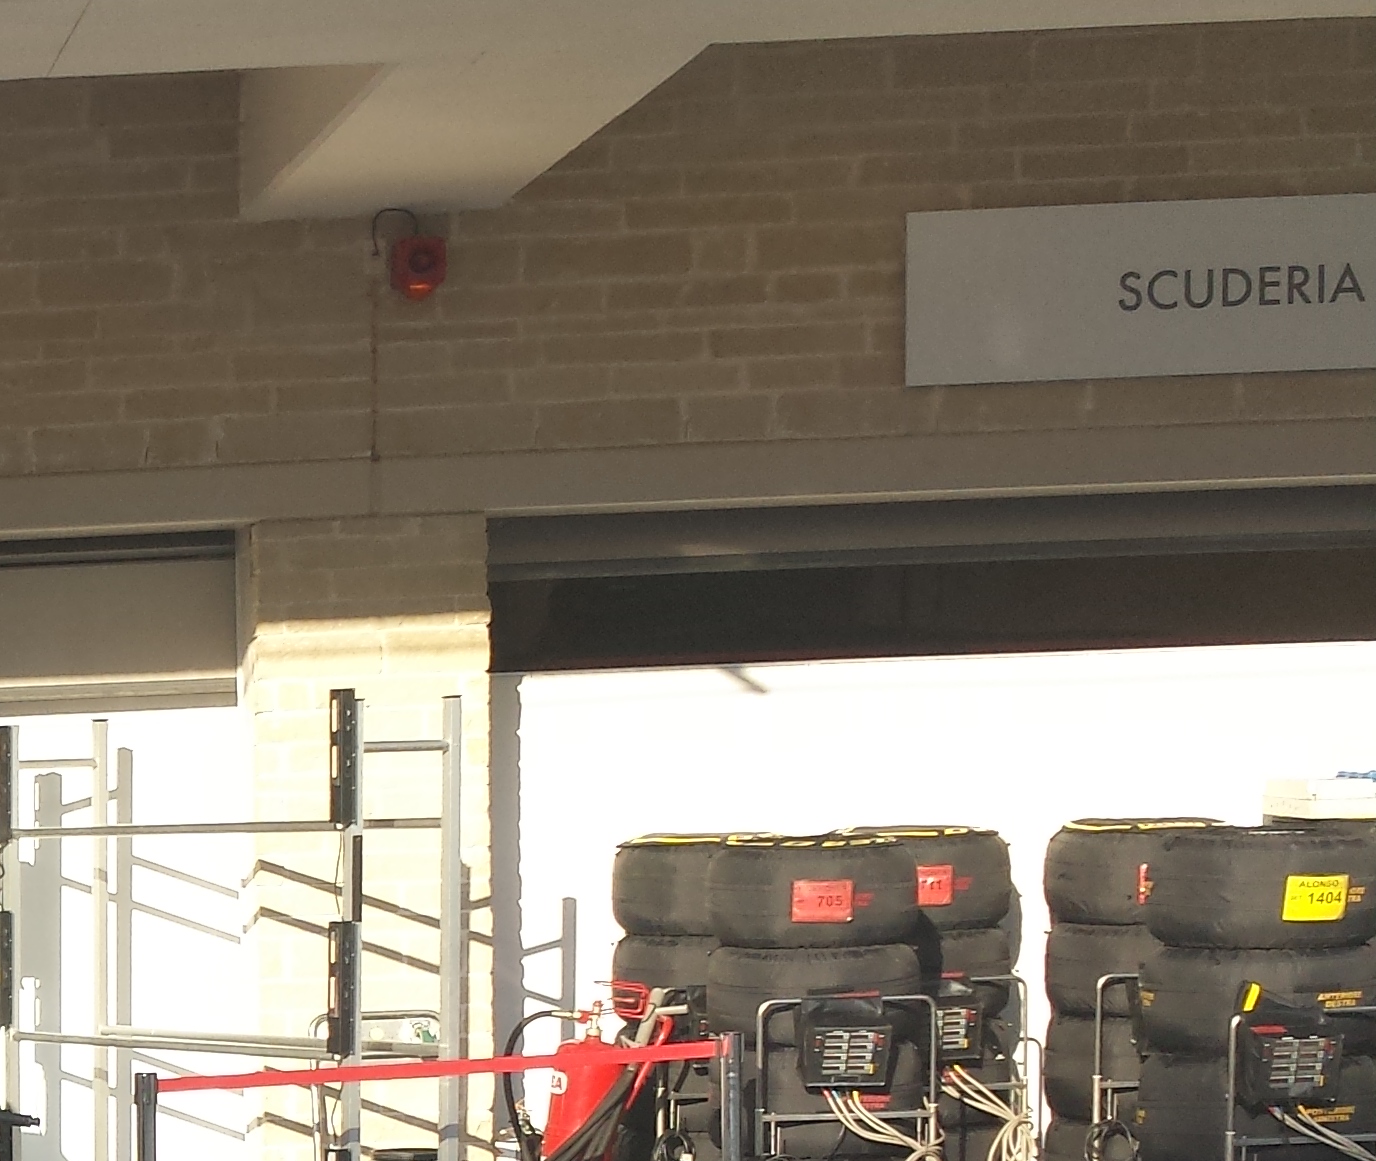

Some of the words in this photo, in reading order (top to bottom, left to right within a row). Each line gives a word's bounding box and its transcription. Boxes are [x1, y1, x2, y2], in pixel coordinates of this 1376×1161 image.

[1117, 262, 1366, 312] SCUDERIA
[1298, 879, 1339, 888] ALONSO
[817, 895, 843, 908] 705
[1307, 891, 1342, 905] 1404
